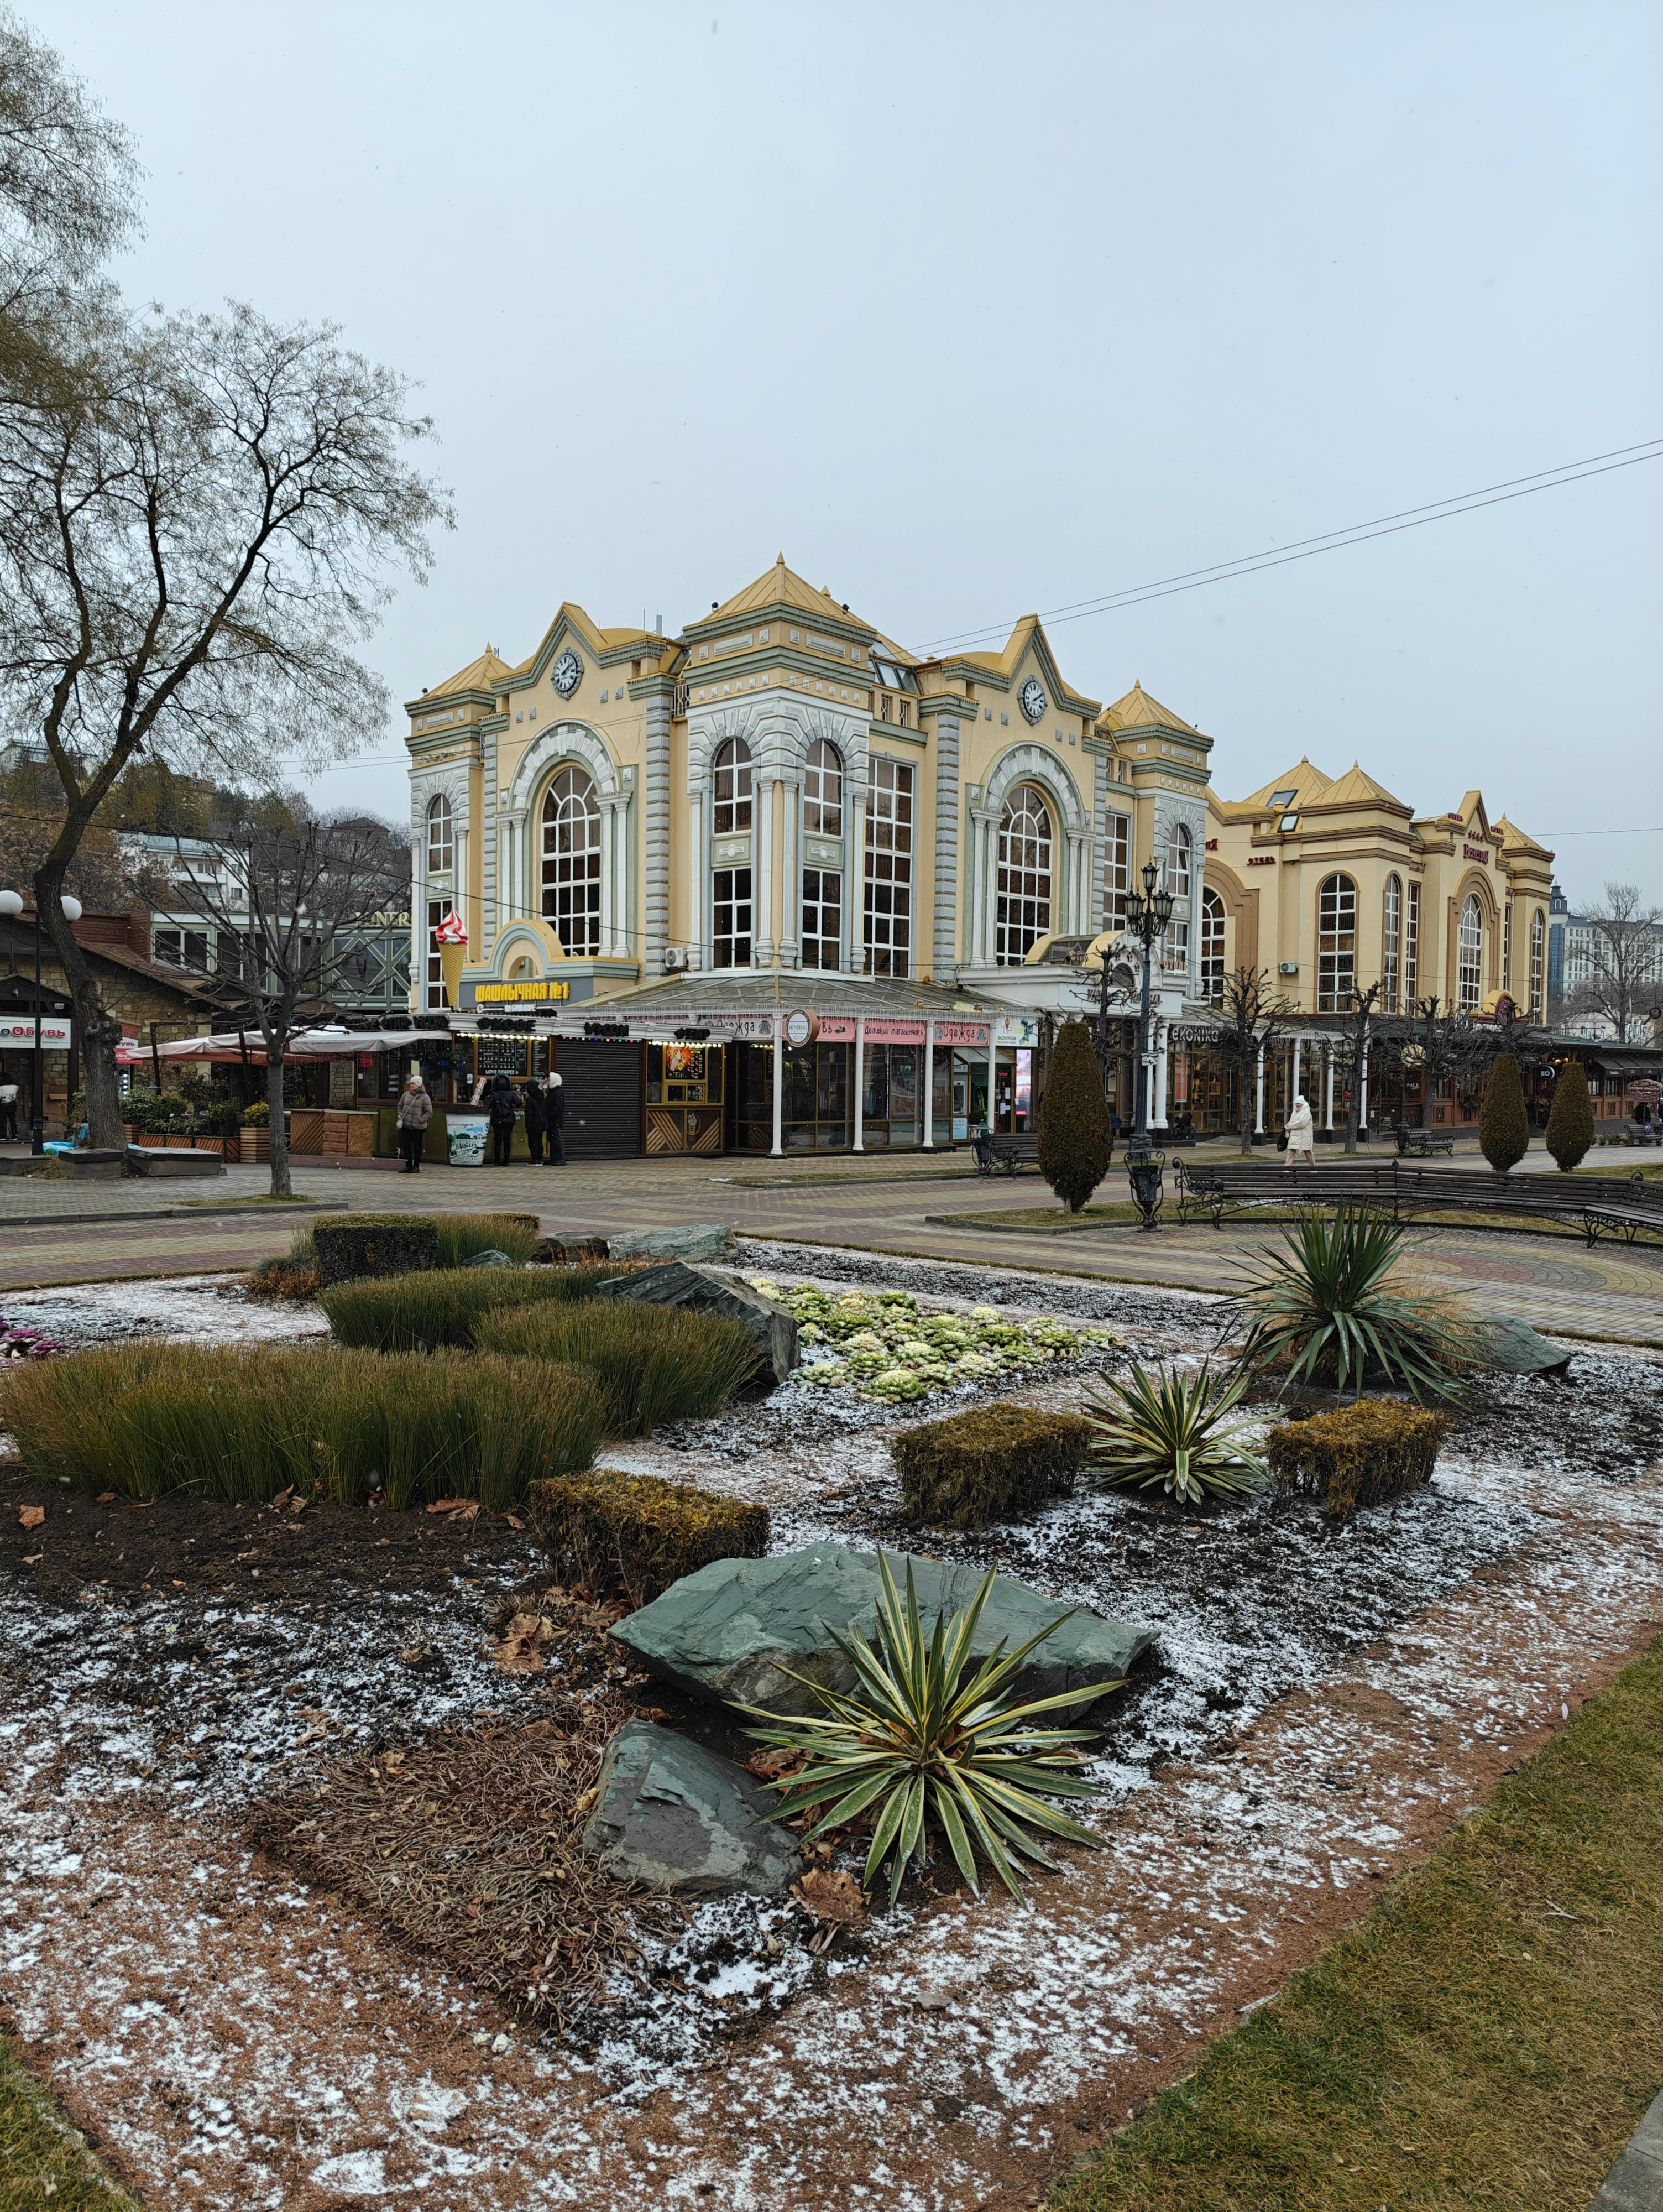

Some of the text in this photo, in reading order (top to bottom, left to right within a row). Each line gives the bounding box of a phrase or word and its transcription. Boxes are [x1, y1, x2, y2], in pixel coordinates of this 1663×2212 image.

[475, 982, 569, 1002] ШАШЛЫЧНАЯ №1
[943, 1026, 975, 1042] Одежда
